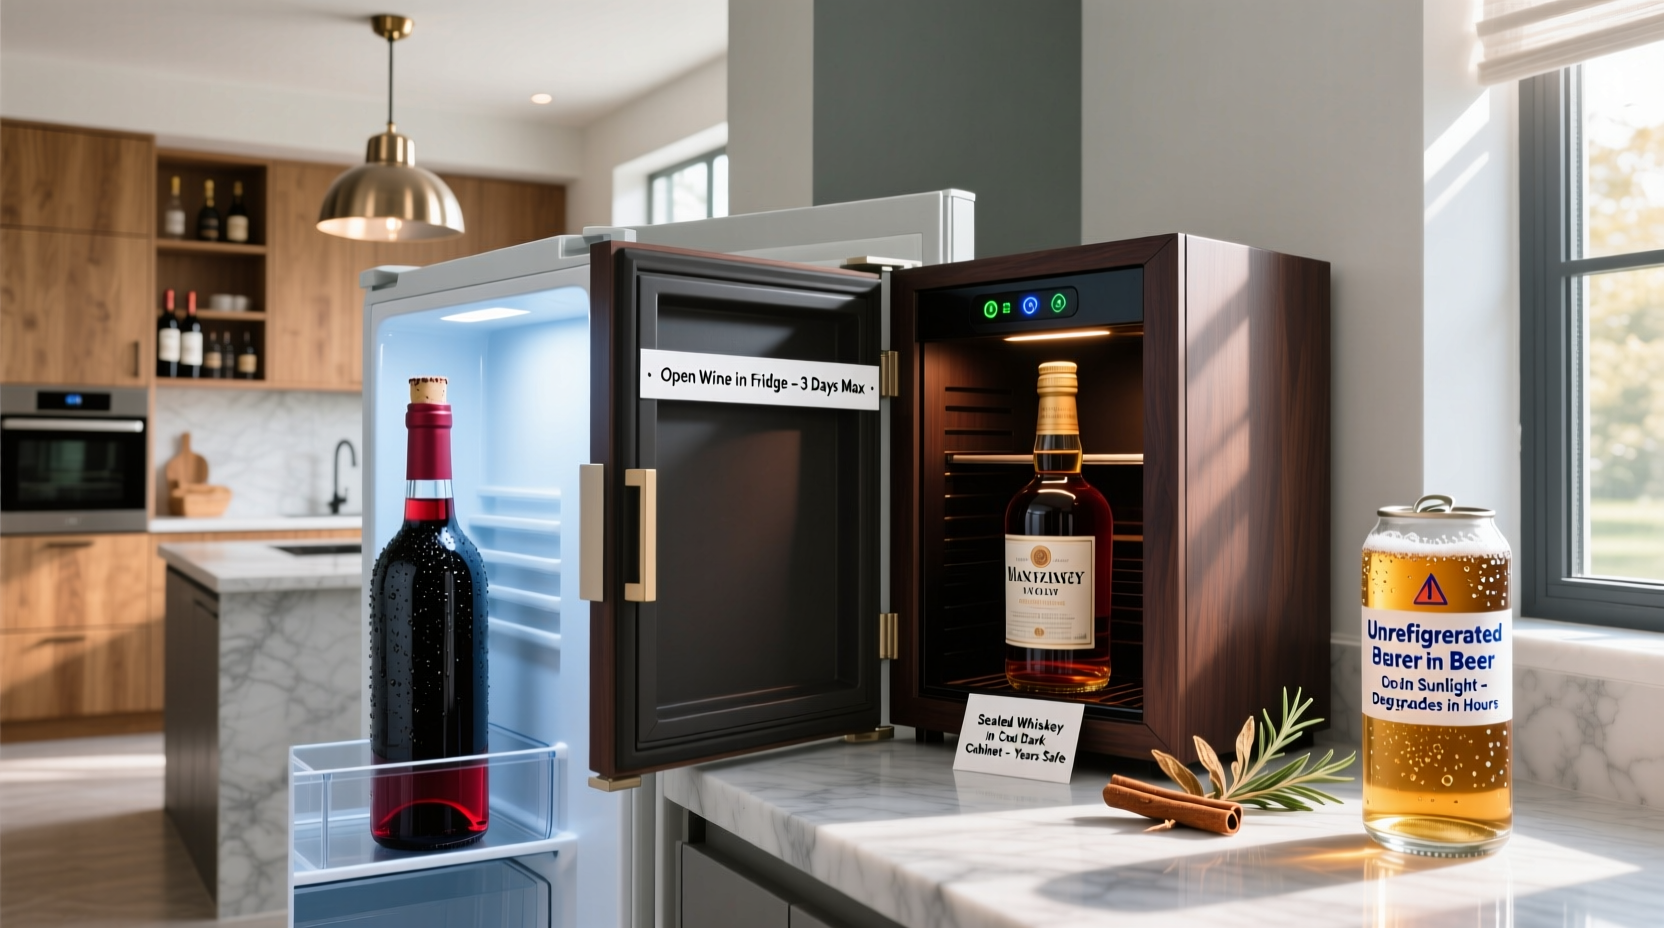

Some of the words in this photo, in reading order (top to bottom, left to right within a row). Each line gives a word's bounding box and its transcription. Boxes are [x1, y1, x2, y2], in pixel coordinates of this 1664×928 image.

[661, 367, 695, 386] Open
[699, 370, 732, 386] Wine
[736, 372, 747, 387] in
[751, 373, 788, 392] Fridge
[800, 376, 808, 390] 3
[811, 377, 838, 396] Days
[842, 379, 865, 395] Max
[1368, 619, 1502, 648] Unrefigrerated
[1426, 652, 1443, 670] in
[1450, 651, 1495, 670] Beer
[1418, 677, 1477, 697] Sunlight
[1448, 699, 1459, 711] in
[1464, 698, 1498, 711] Hours
[978, 714, 1013, 728] Sealed
[1017, 716, 1064, 735] Whiskey
[1021, 733, 1046, 746] Dark
